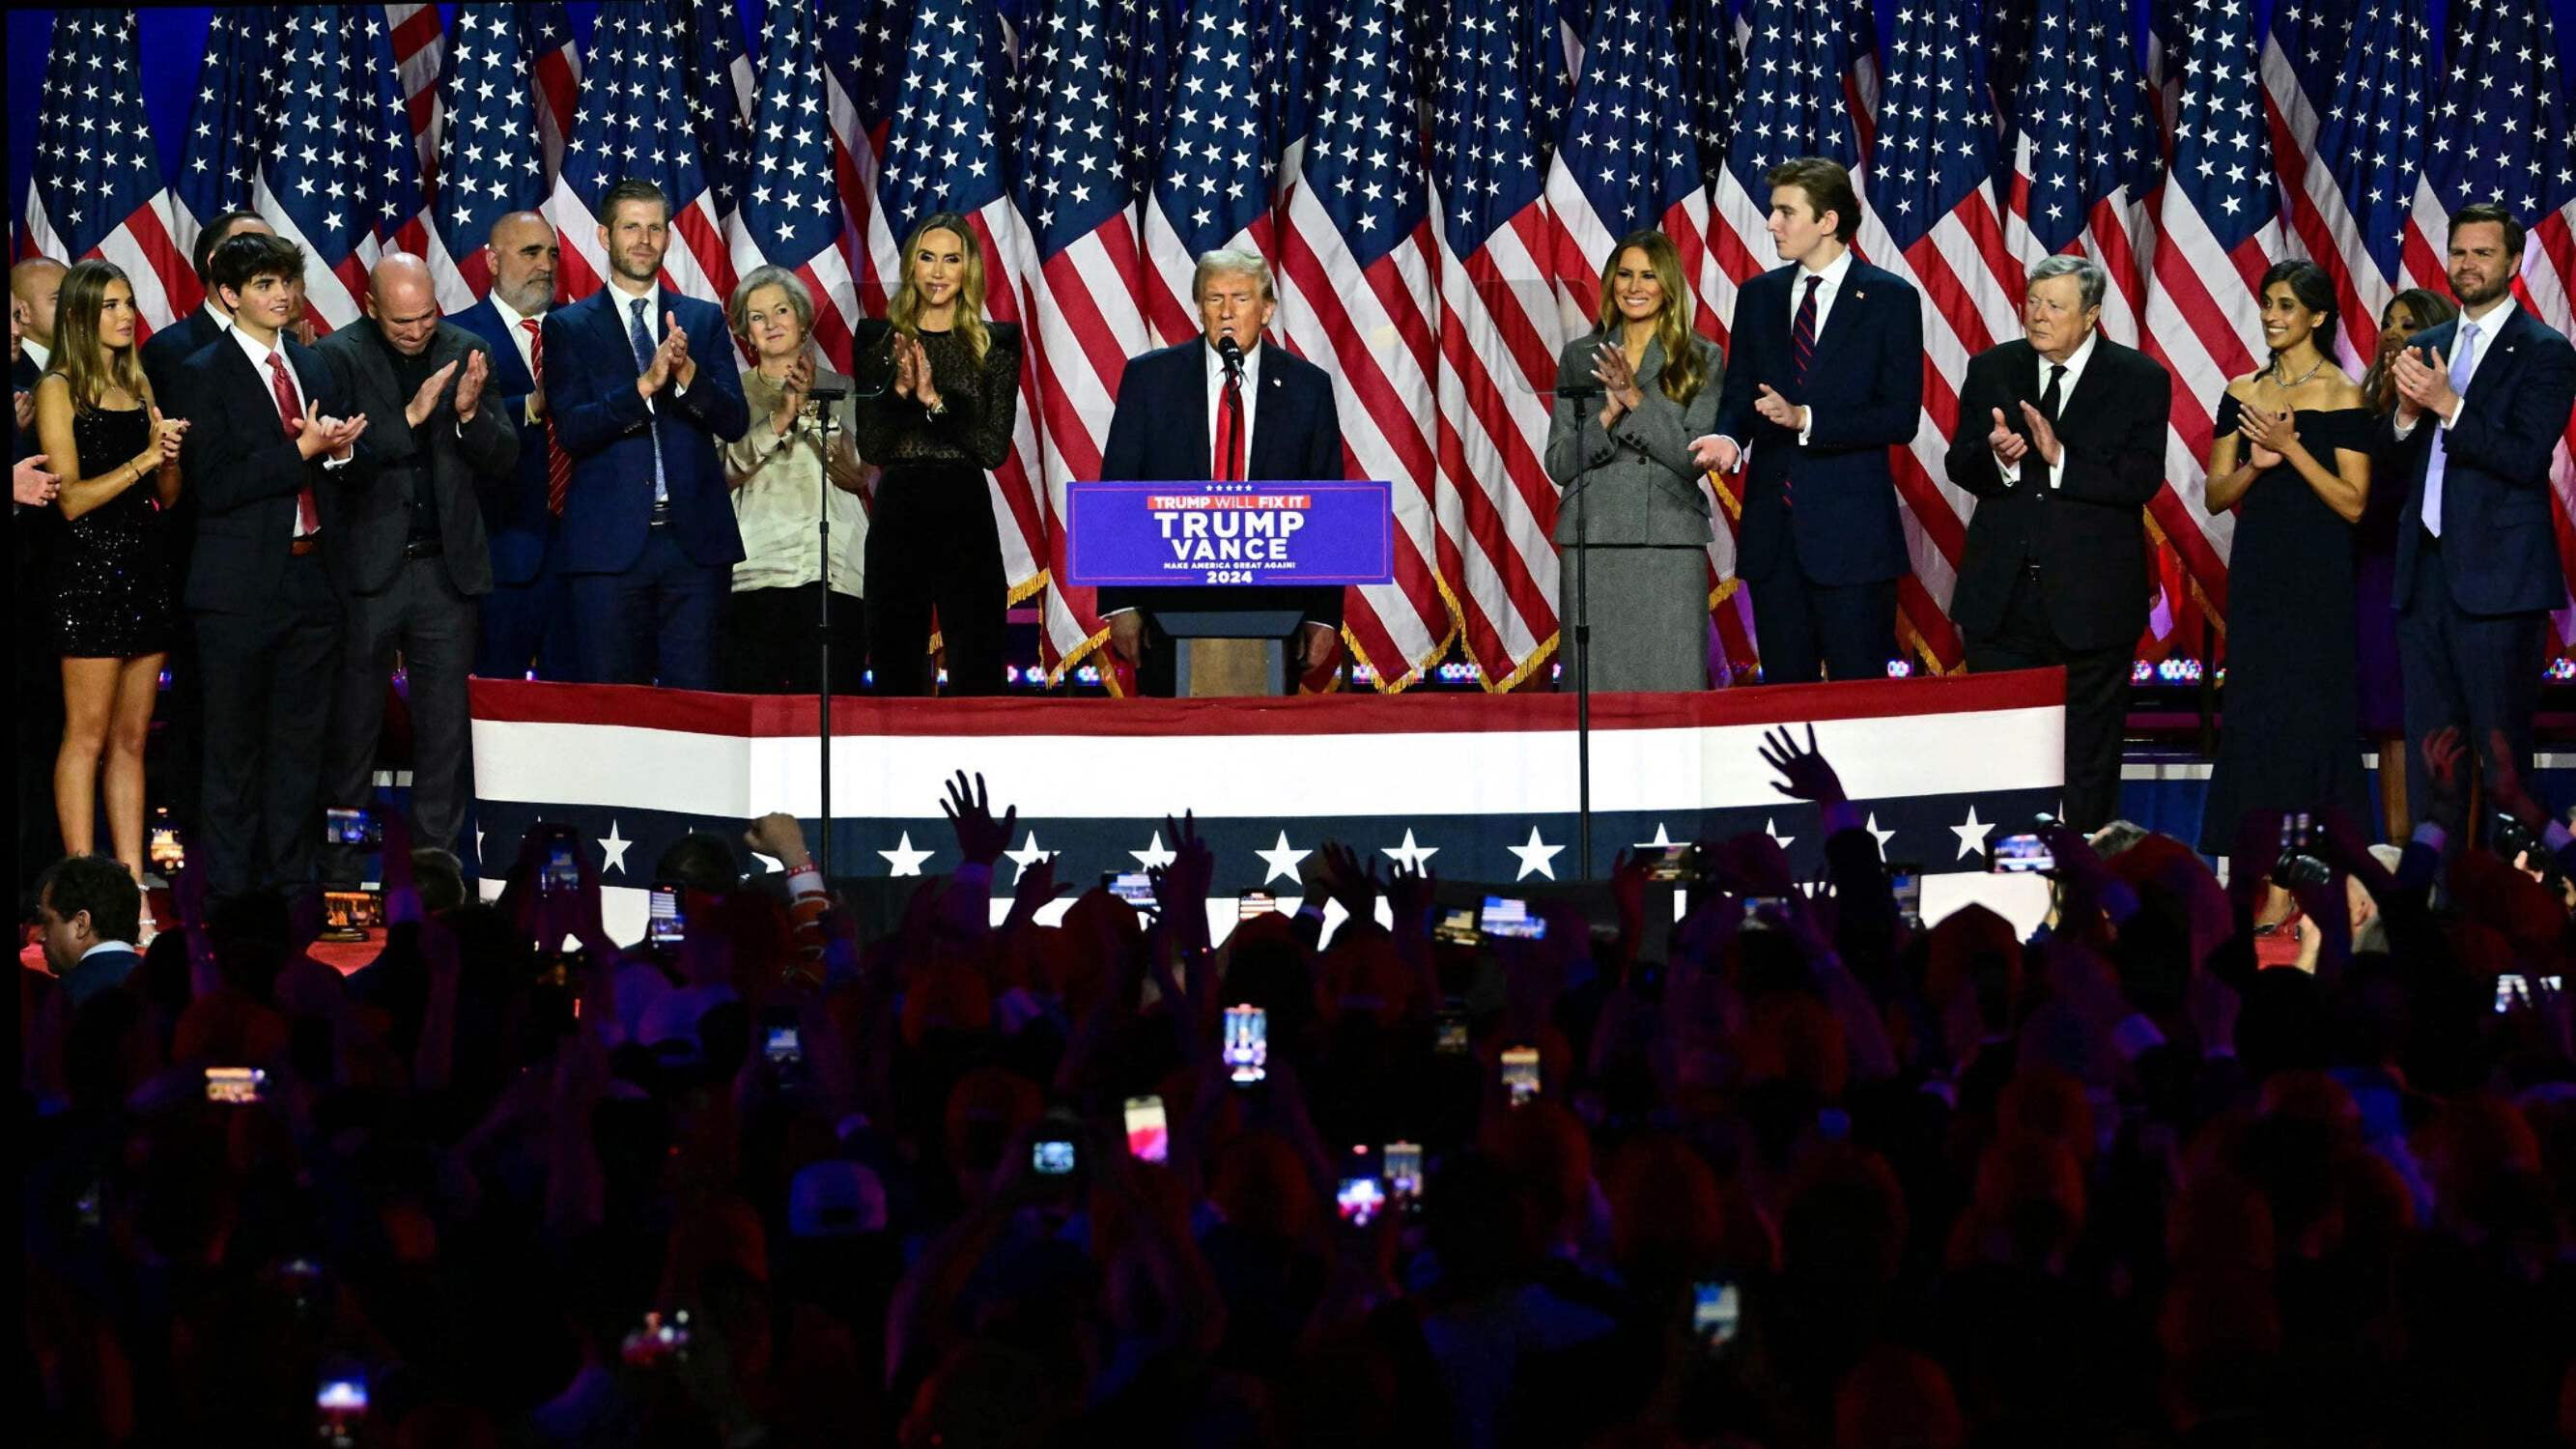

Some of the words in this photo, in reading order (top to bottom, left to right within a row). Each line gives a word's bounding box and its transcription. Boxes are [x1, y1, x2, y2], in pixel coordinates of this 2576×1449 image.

[1153, 496, 1211, 509] TRUMP
[1214, 495, 1255, 509] WILL
[1259, 495, 1286, 509] FIX
[1288, 495, 1305, 509] IT
[1153, 511, 1305, 538] TRUMP
[1171, 538, 1288, 560] VANCE
[1206, 570, 1253, 584] 2024
